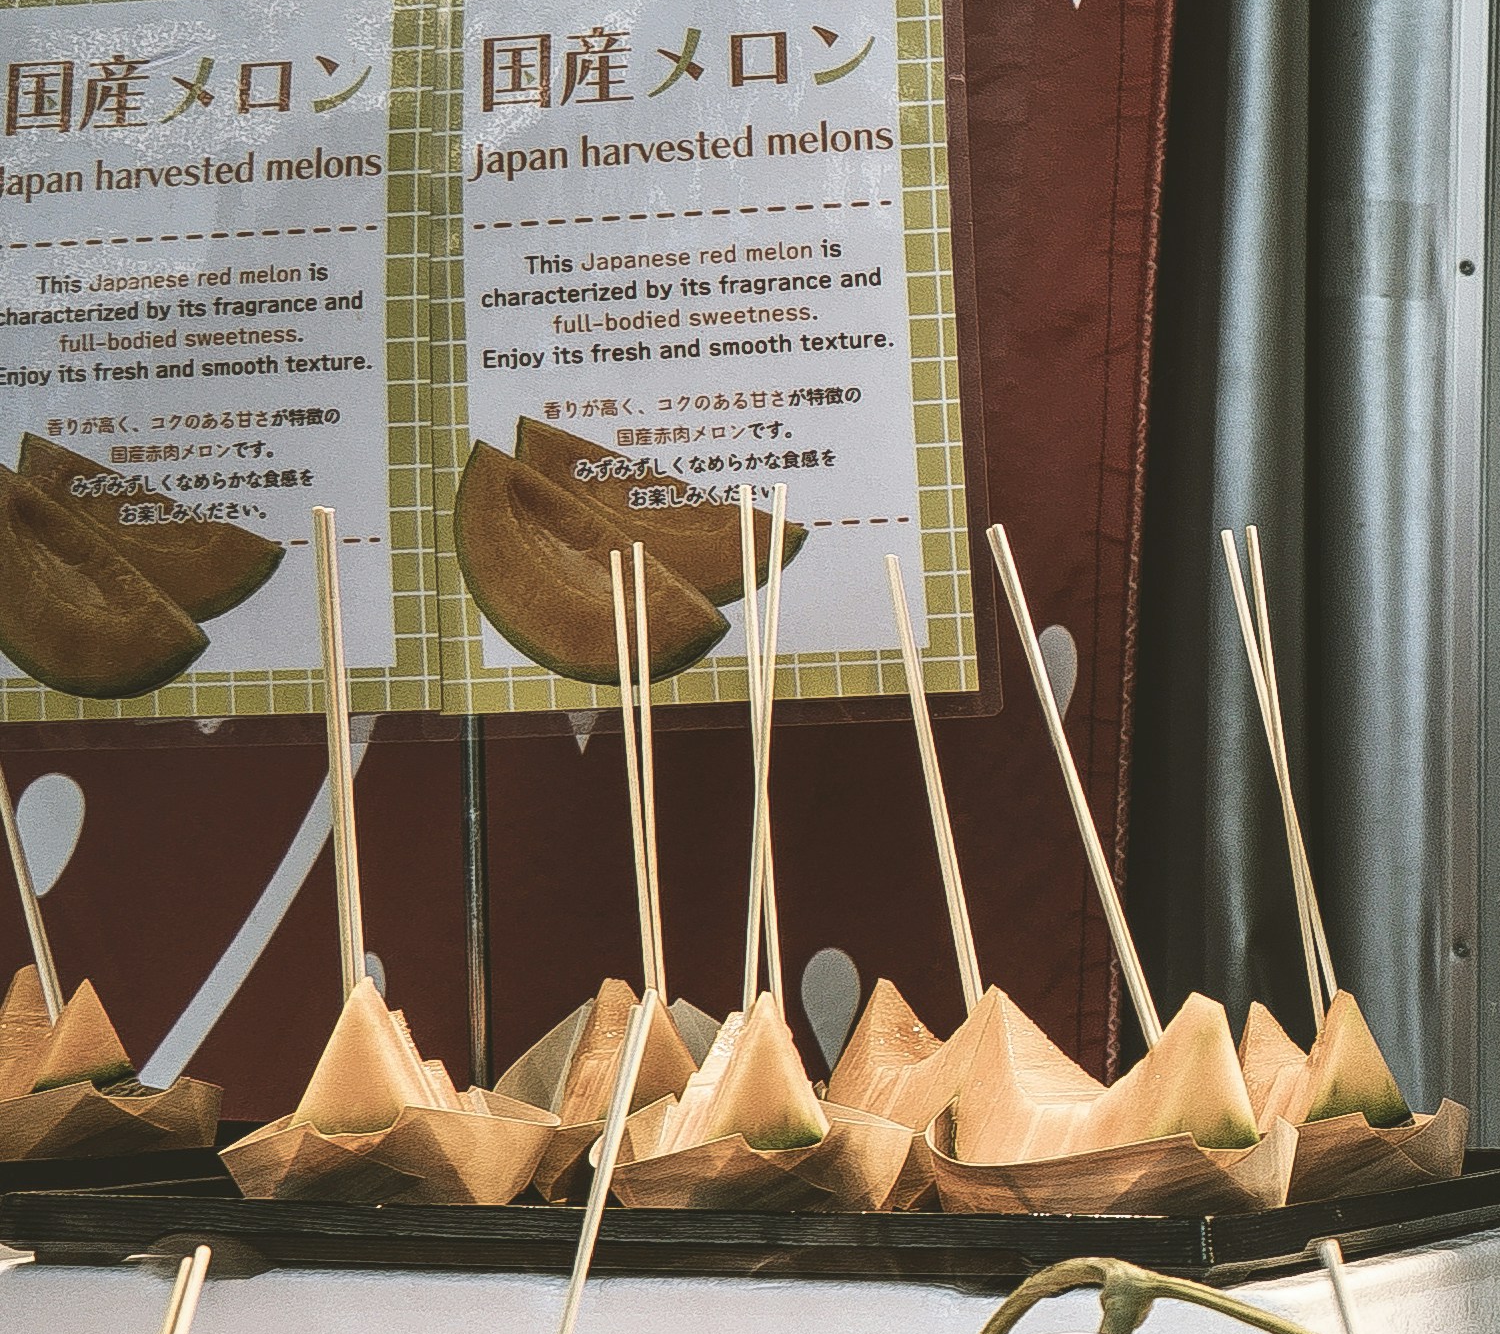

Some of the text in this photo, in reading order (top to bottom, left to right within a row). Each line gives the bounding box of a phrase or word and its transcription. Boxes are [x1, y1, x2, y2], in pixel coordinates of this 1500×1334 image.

[481, 25, 876, 113] 国産メロン
[5, 55, 373, 136] 国産メロン
[467, 120, 894, 182] Japan harvested melons
[96, 151, 254, 190] harvested
[266, 147, 382, 181] melons
[524, 239, 842, 275] This Japanese red melon is
[37, 263, 328, 295] This Japanese red melon is
[481, 267, 882, 308] characterized by its fragrance and
[146, 300, 172, 323] by
[178, 298, 206, 317] its
[212, 296, 318, 318] fragrance
[324, 291, 363, 310] and
[552, 304, 818, 334] full-bodied sweetness.
[59, 326, 304, 353] full-bodied sweetness.
[483, 331, 894, 369] Enjoy its fresh and smooth texture.
[58, 364, 87, 384] its
[93, 361, 150, 382] fresh
[156, 359, 195, 379] and
[201, 354, 279, 377] smooth
[286, 352, 372, 373] texture.
[616, 421, 794, 447] 国産赤肉メロンです。
[119, 504, 268, 525] お楽しみください。
